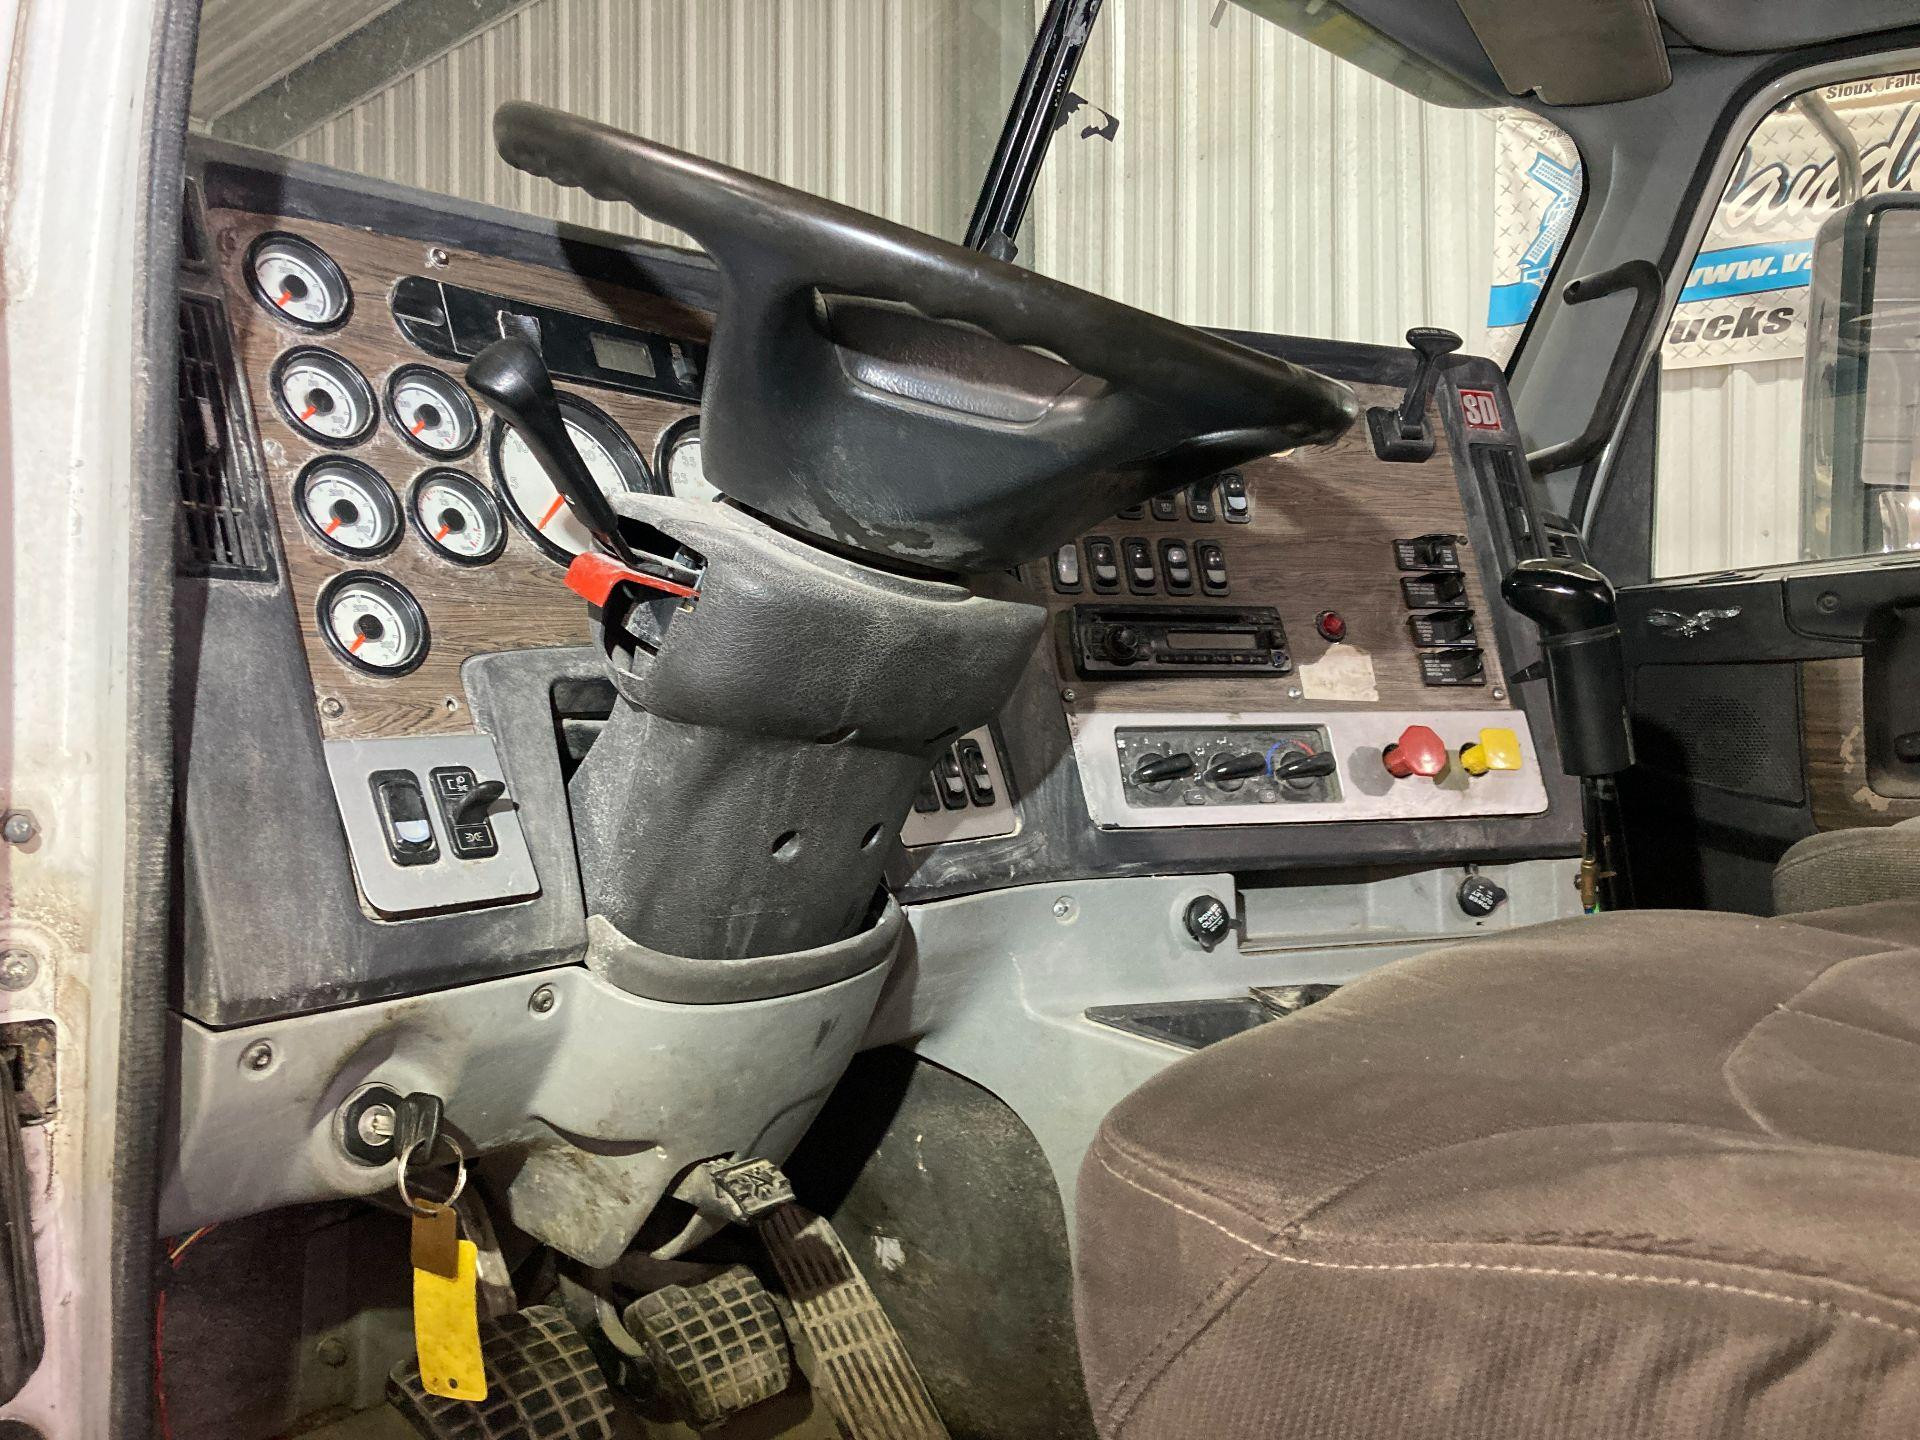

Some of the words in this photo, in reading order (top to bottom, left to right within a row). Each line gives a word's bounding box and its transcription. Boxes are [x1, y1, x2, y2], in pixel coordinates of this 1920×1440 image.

[1826, 82, 1873, 99] Sioux
[1669, 306, 1794, 345] ucks
[1462, 394, 1499, 425] SD
[1198, 903, 1219, 924] POWER
[1201, 907, 1222, 929] OUTLET
